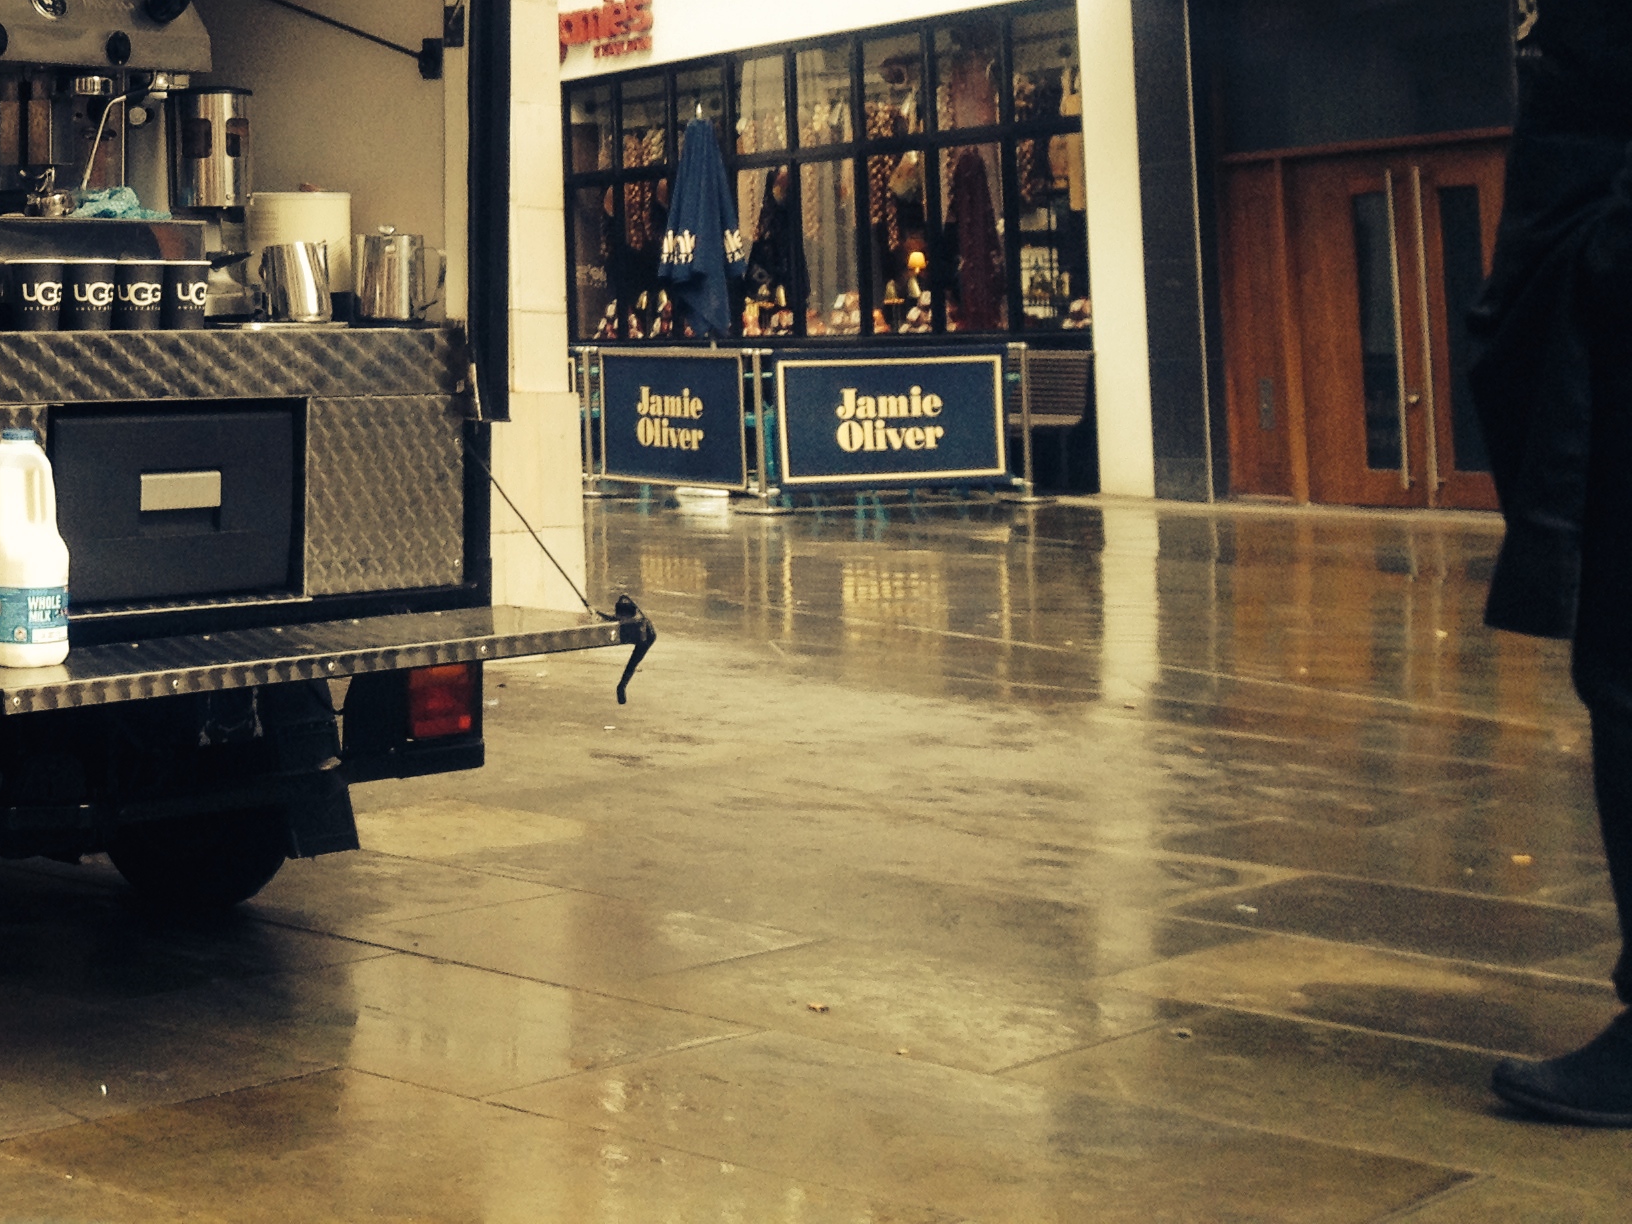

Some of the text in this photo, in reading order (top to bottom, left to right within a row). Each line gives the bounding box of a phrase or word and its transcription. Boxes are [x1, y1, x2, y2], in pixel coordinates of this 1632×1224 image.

[118, 281, 162, 306] UGG
[636, 385, 704, 420] Jamie
[835, 385, 944, 419] Jamie
[636, 417, 705, 451] Oliver
[836, 418, 945, 453] Oliver
[27, 594, 62, 611] WHOLE
[28, 609, 52, 623] MILK
